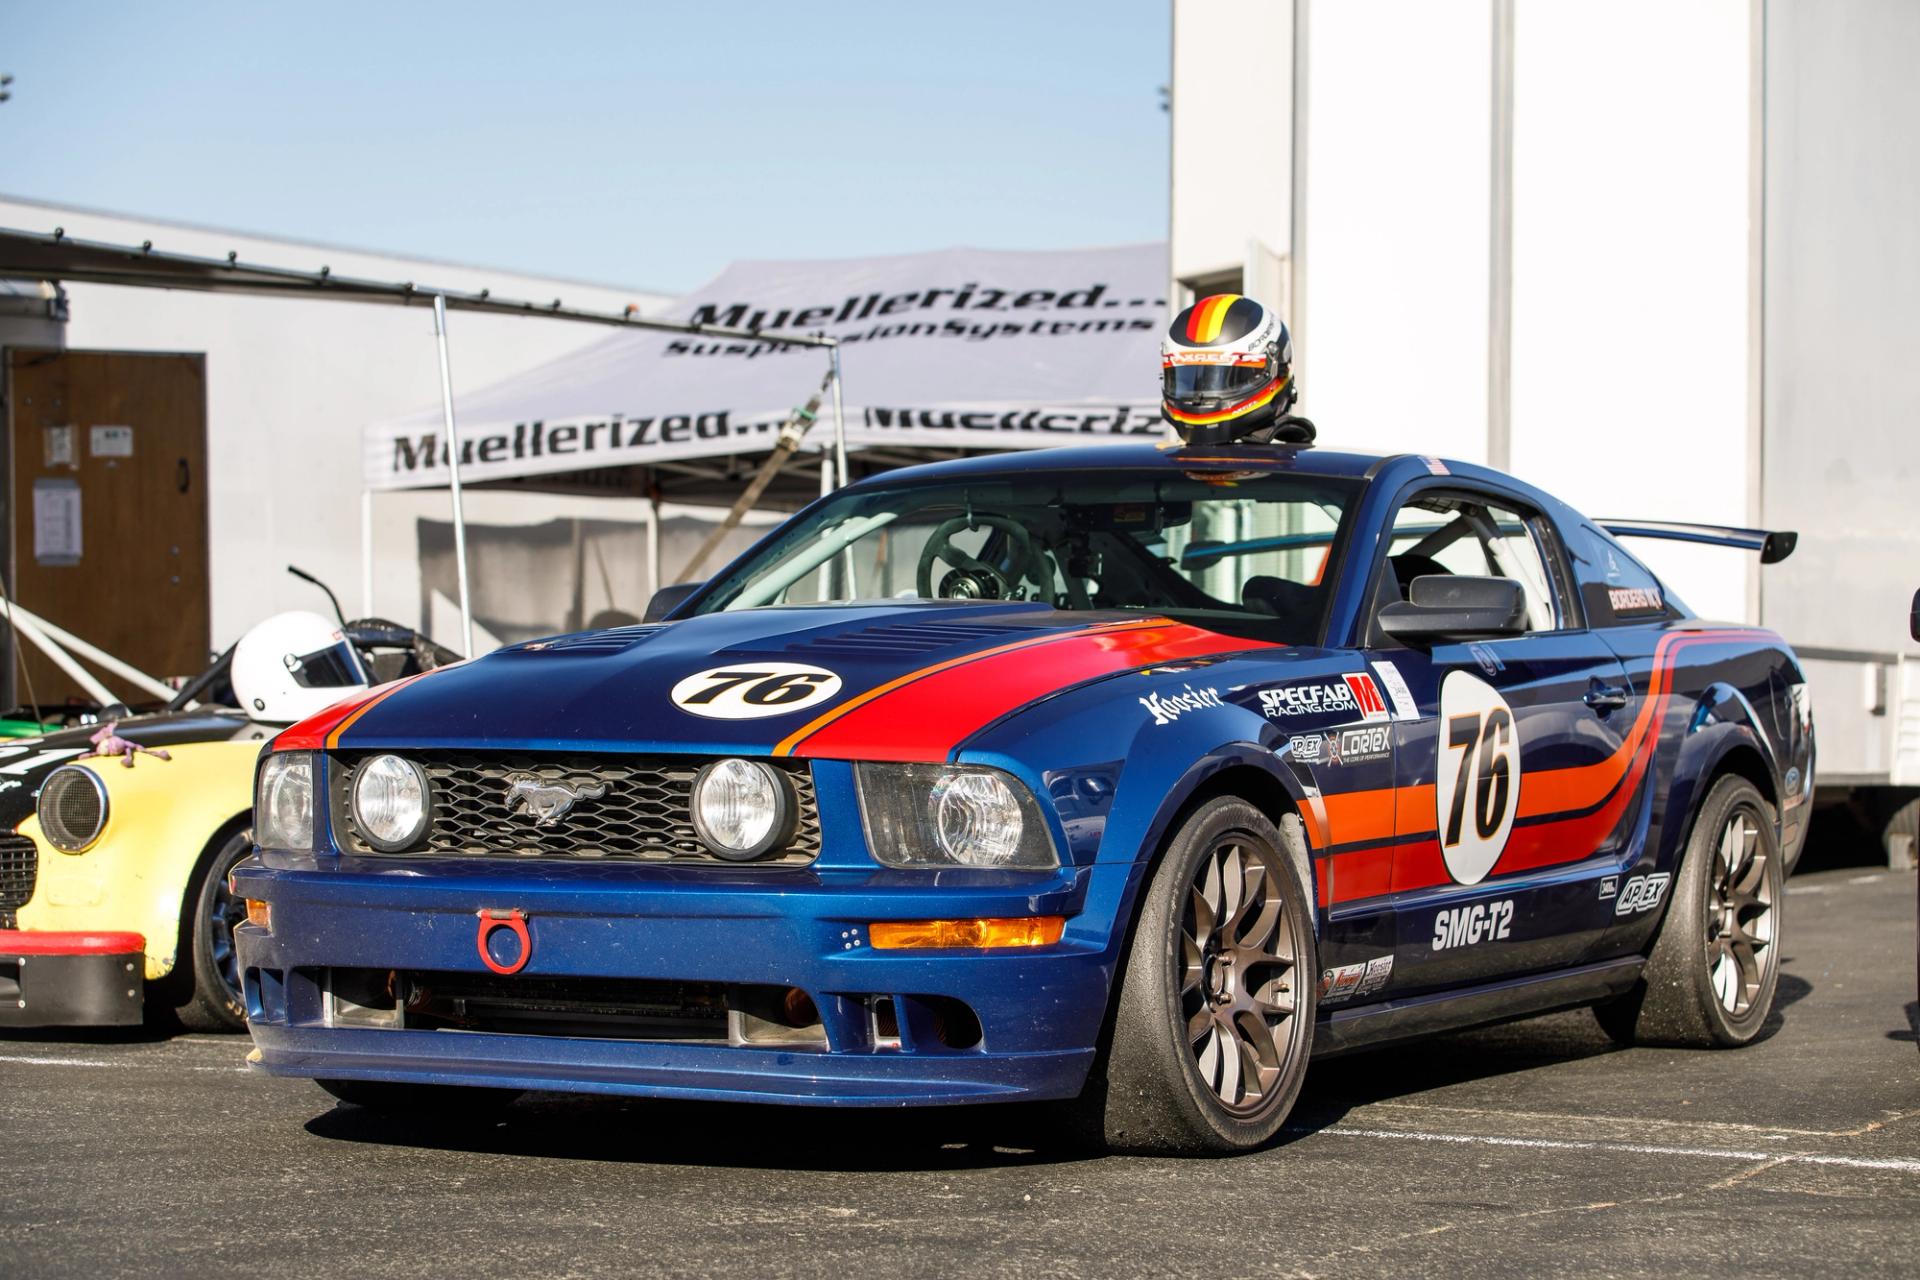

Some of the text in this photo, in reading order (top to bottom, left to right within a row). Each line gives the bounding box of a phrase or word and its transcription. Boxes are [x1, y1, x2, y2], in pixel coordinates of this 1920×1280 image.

[681, 671, 835, 706] 76
[1138, 683, 1225, 726] Hoosier
[1257, 683, 1352, 709] SPECFAB
[1264, 700, 1358, 718] RACING.COM
[1444, 707, 1511, 849] 76
[1432, 899, 1514, 951] SMG-T2
